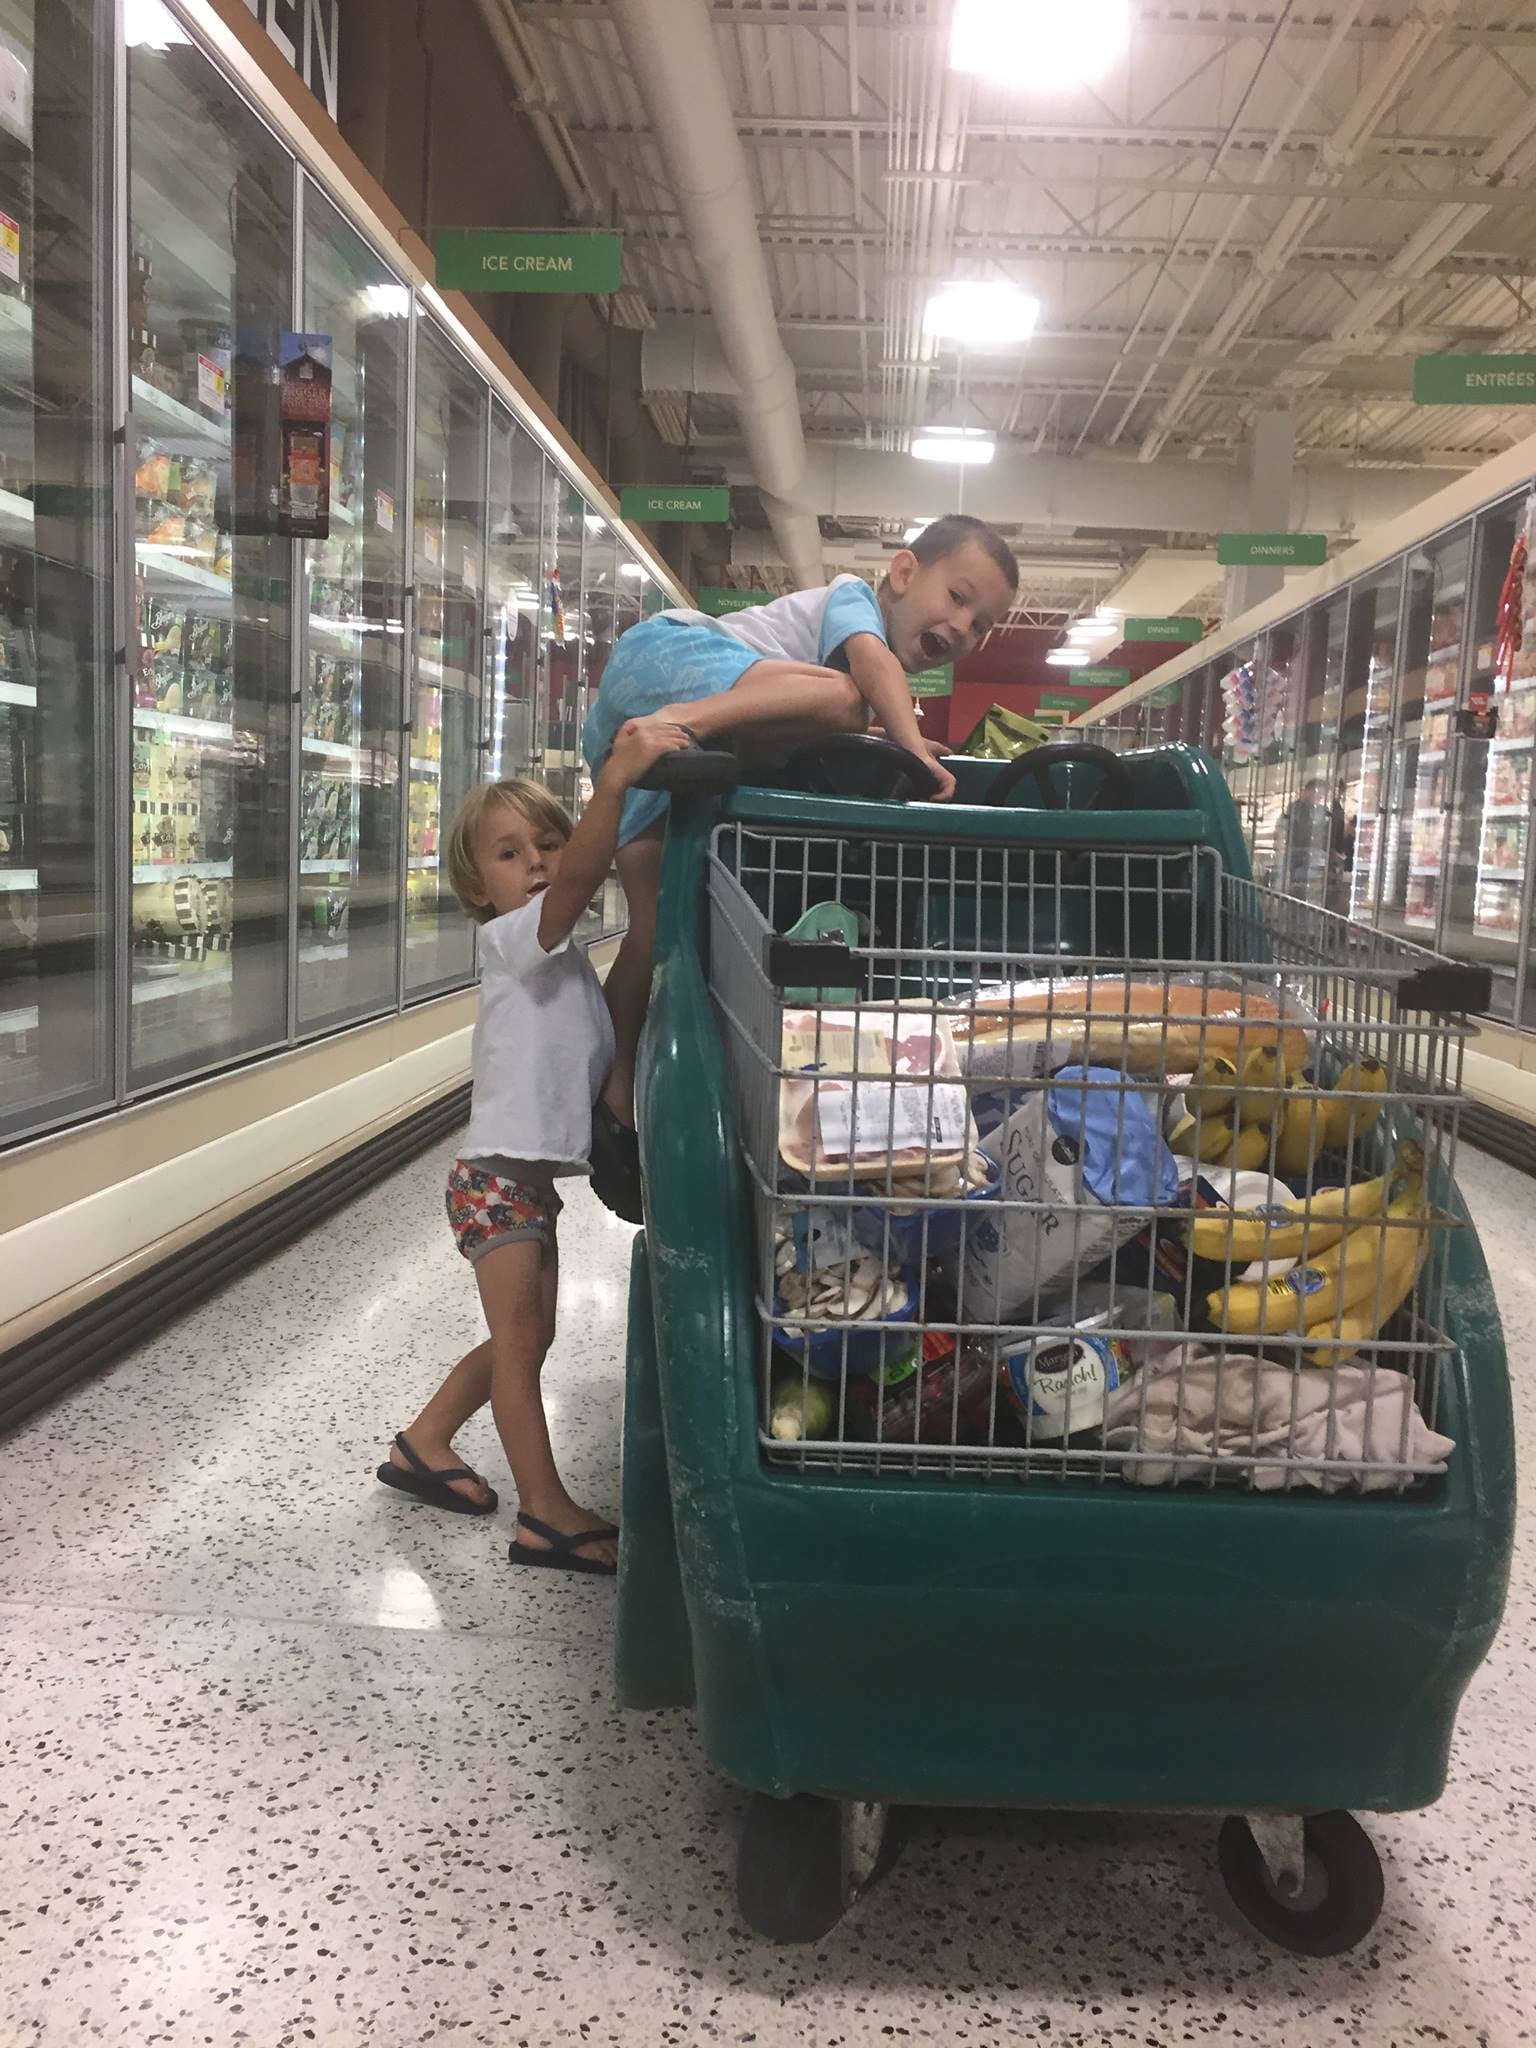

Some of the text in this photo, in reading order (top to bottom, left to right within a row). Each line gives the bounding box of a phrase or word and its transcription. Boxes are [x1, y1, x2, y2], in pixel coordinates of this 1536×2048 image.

[482, 255, 573, 271] ICE CREAM
[1465, 370, 1535, 387] ENTRÉES
[648, 499, 702, 510] ICE CREAM
[1250, 545, 1295, 555] DINNERS
[1001, 1128, 1060, 1236] SUGR
[1034, 1363, 1099, 1395] Rach!
